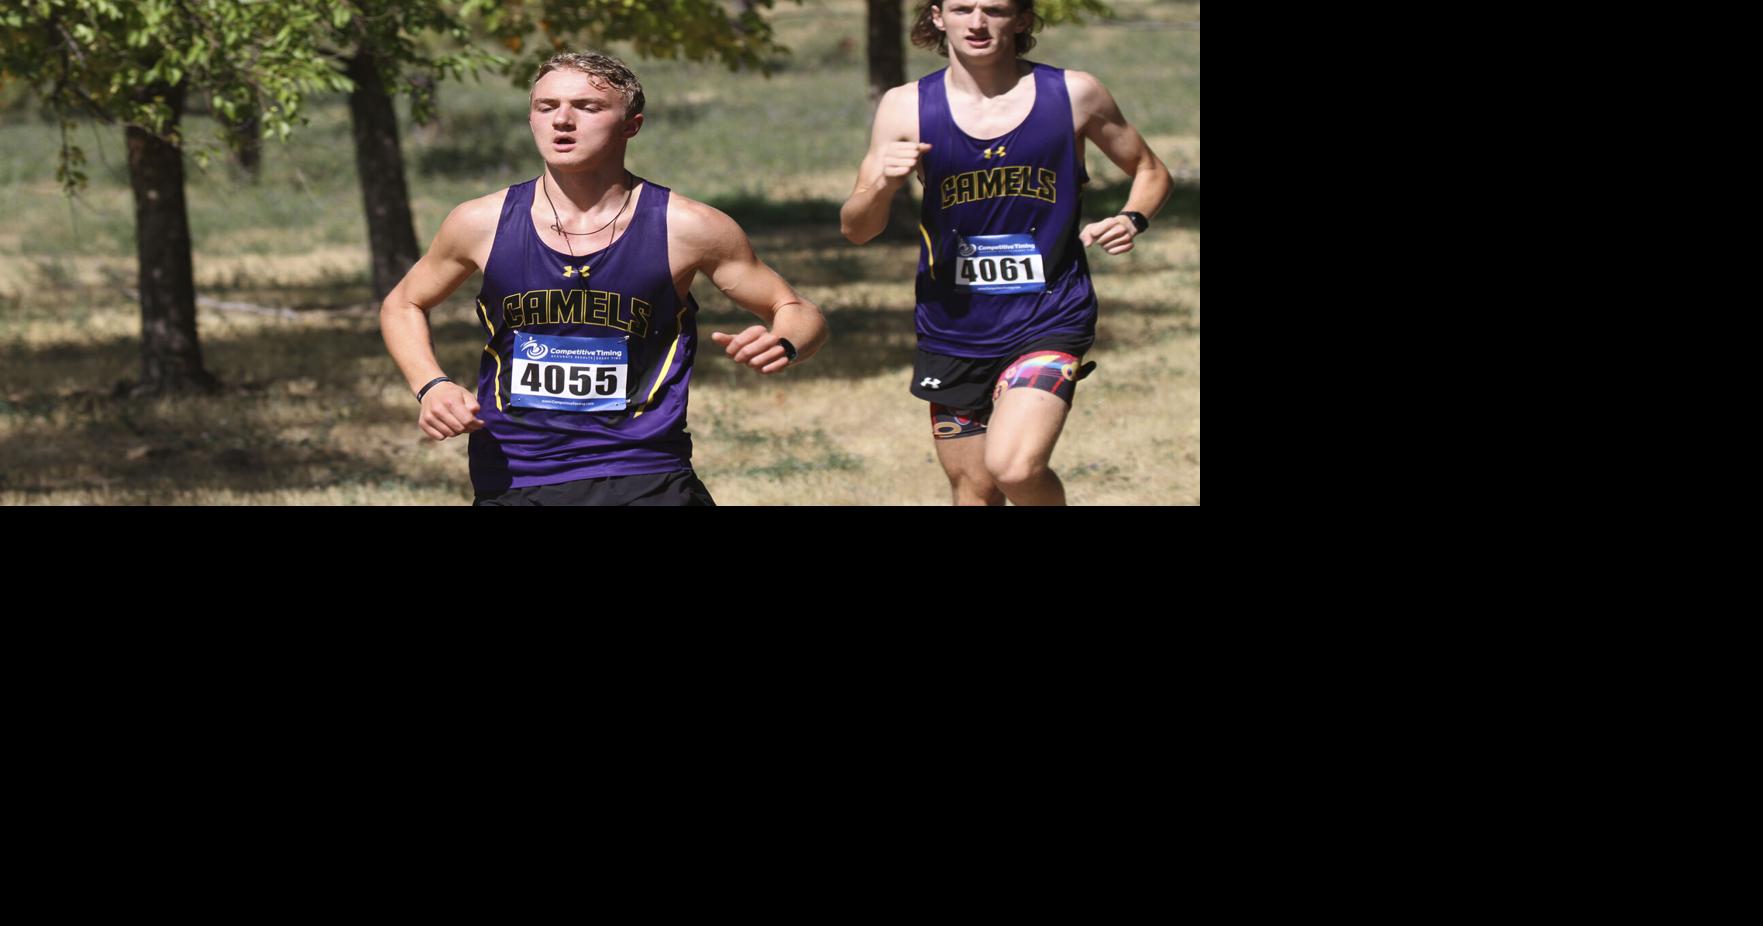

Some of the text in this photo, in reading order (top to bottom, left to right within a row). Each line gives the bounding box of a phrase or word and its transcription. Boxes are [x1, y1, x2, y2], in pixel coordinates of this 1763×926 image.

[940, 165, 1056, 209] CAMELS
[961, 257, 1034, 282] 4061
[502, 289, 651, 338] CAMELS
[520, 362, 618, 396] 4055
